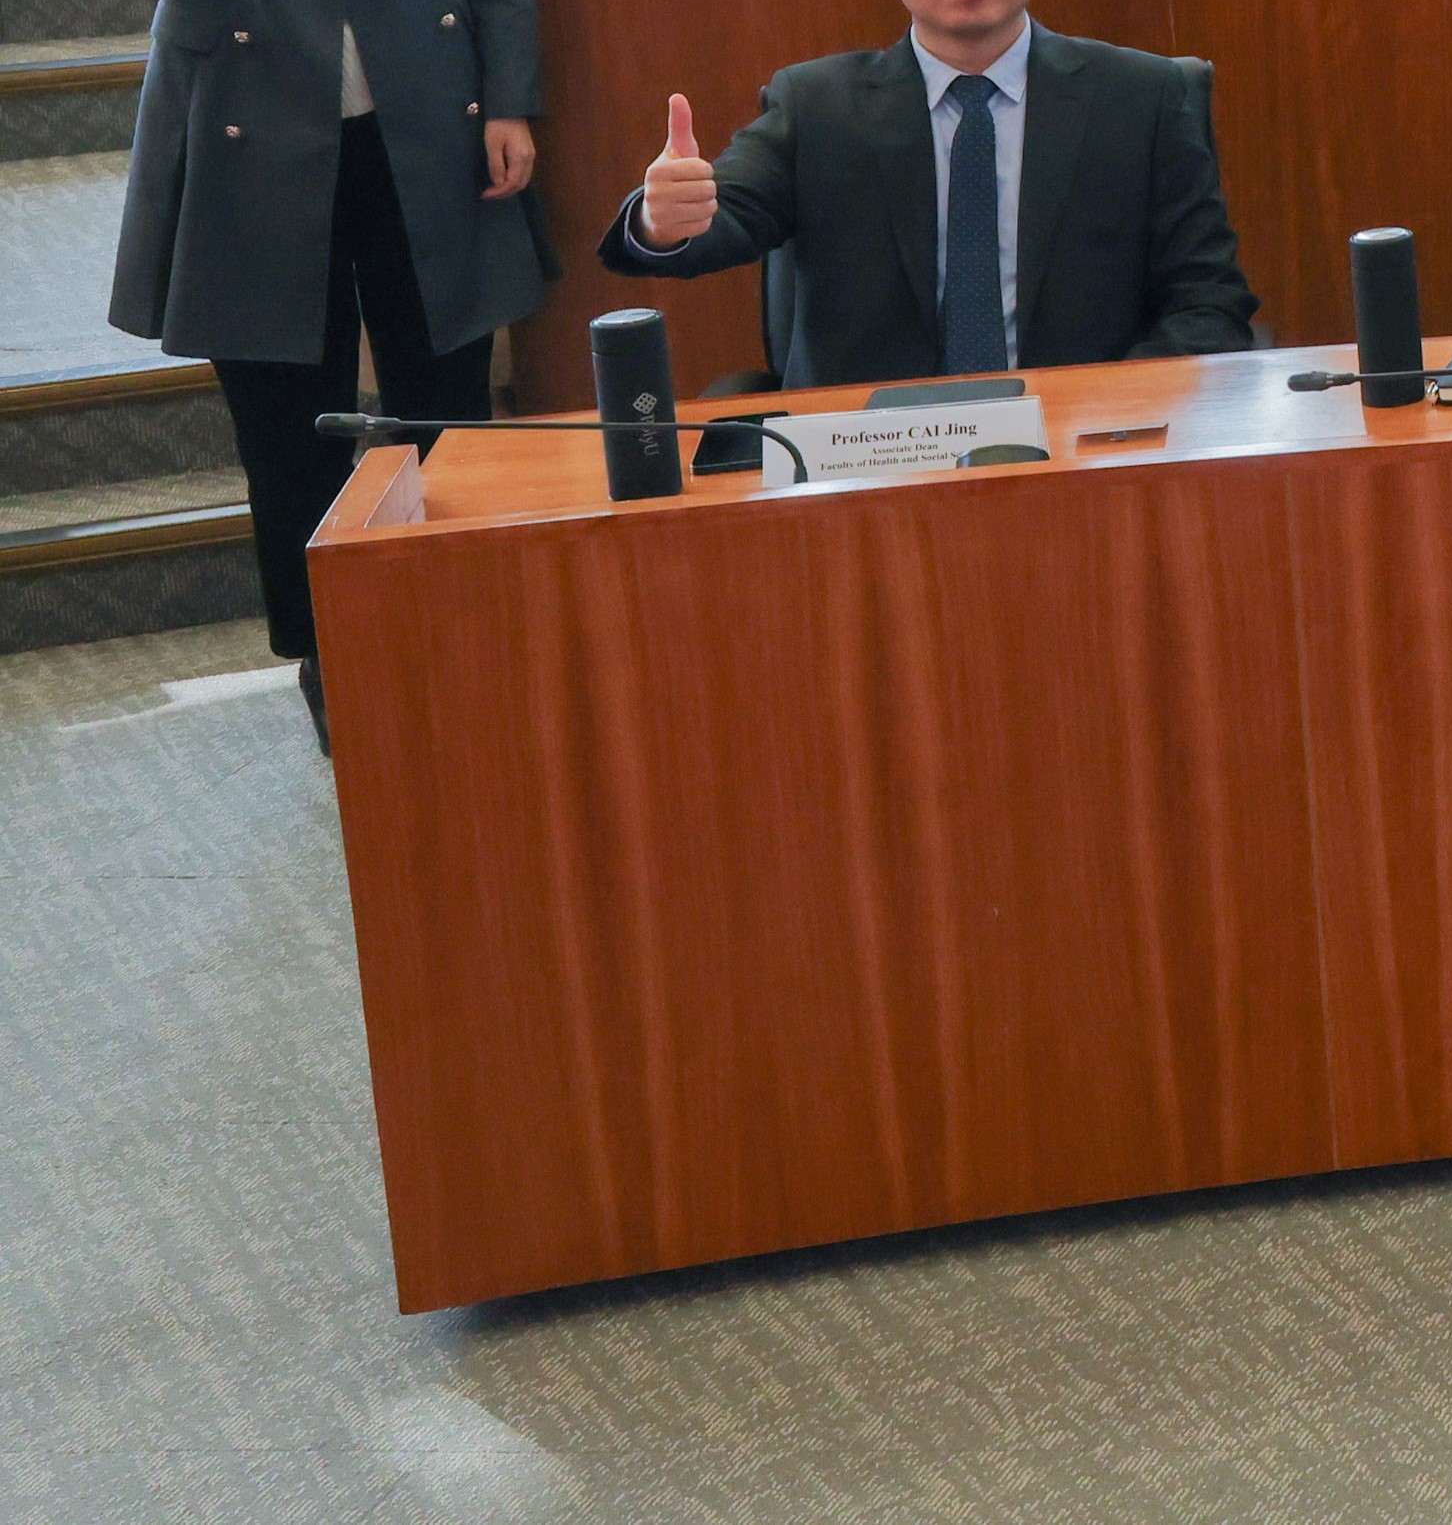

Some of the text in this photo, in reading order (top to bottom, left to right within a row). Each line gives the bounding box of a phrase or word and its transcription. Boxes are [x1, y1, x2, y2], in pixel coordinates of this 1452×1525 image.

[831, 423, 978, 445] Professor CAI Jing
[871, 443, 938, 455] Associate Dean
[820, 461, 854, 471] Faculty
[857, 459, 867, 467] of
[869, 458, 899, 466] Health
[921, 452, 948, 461] Social
